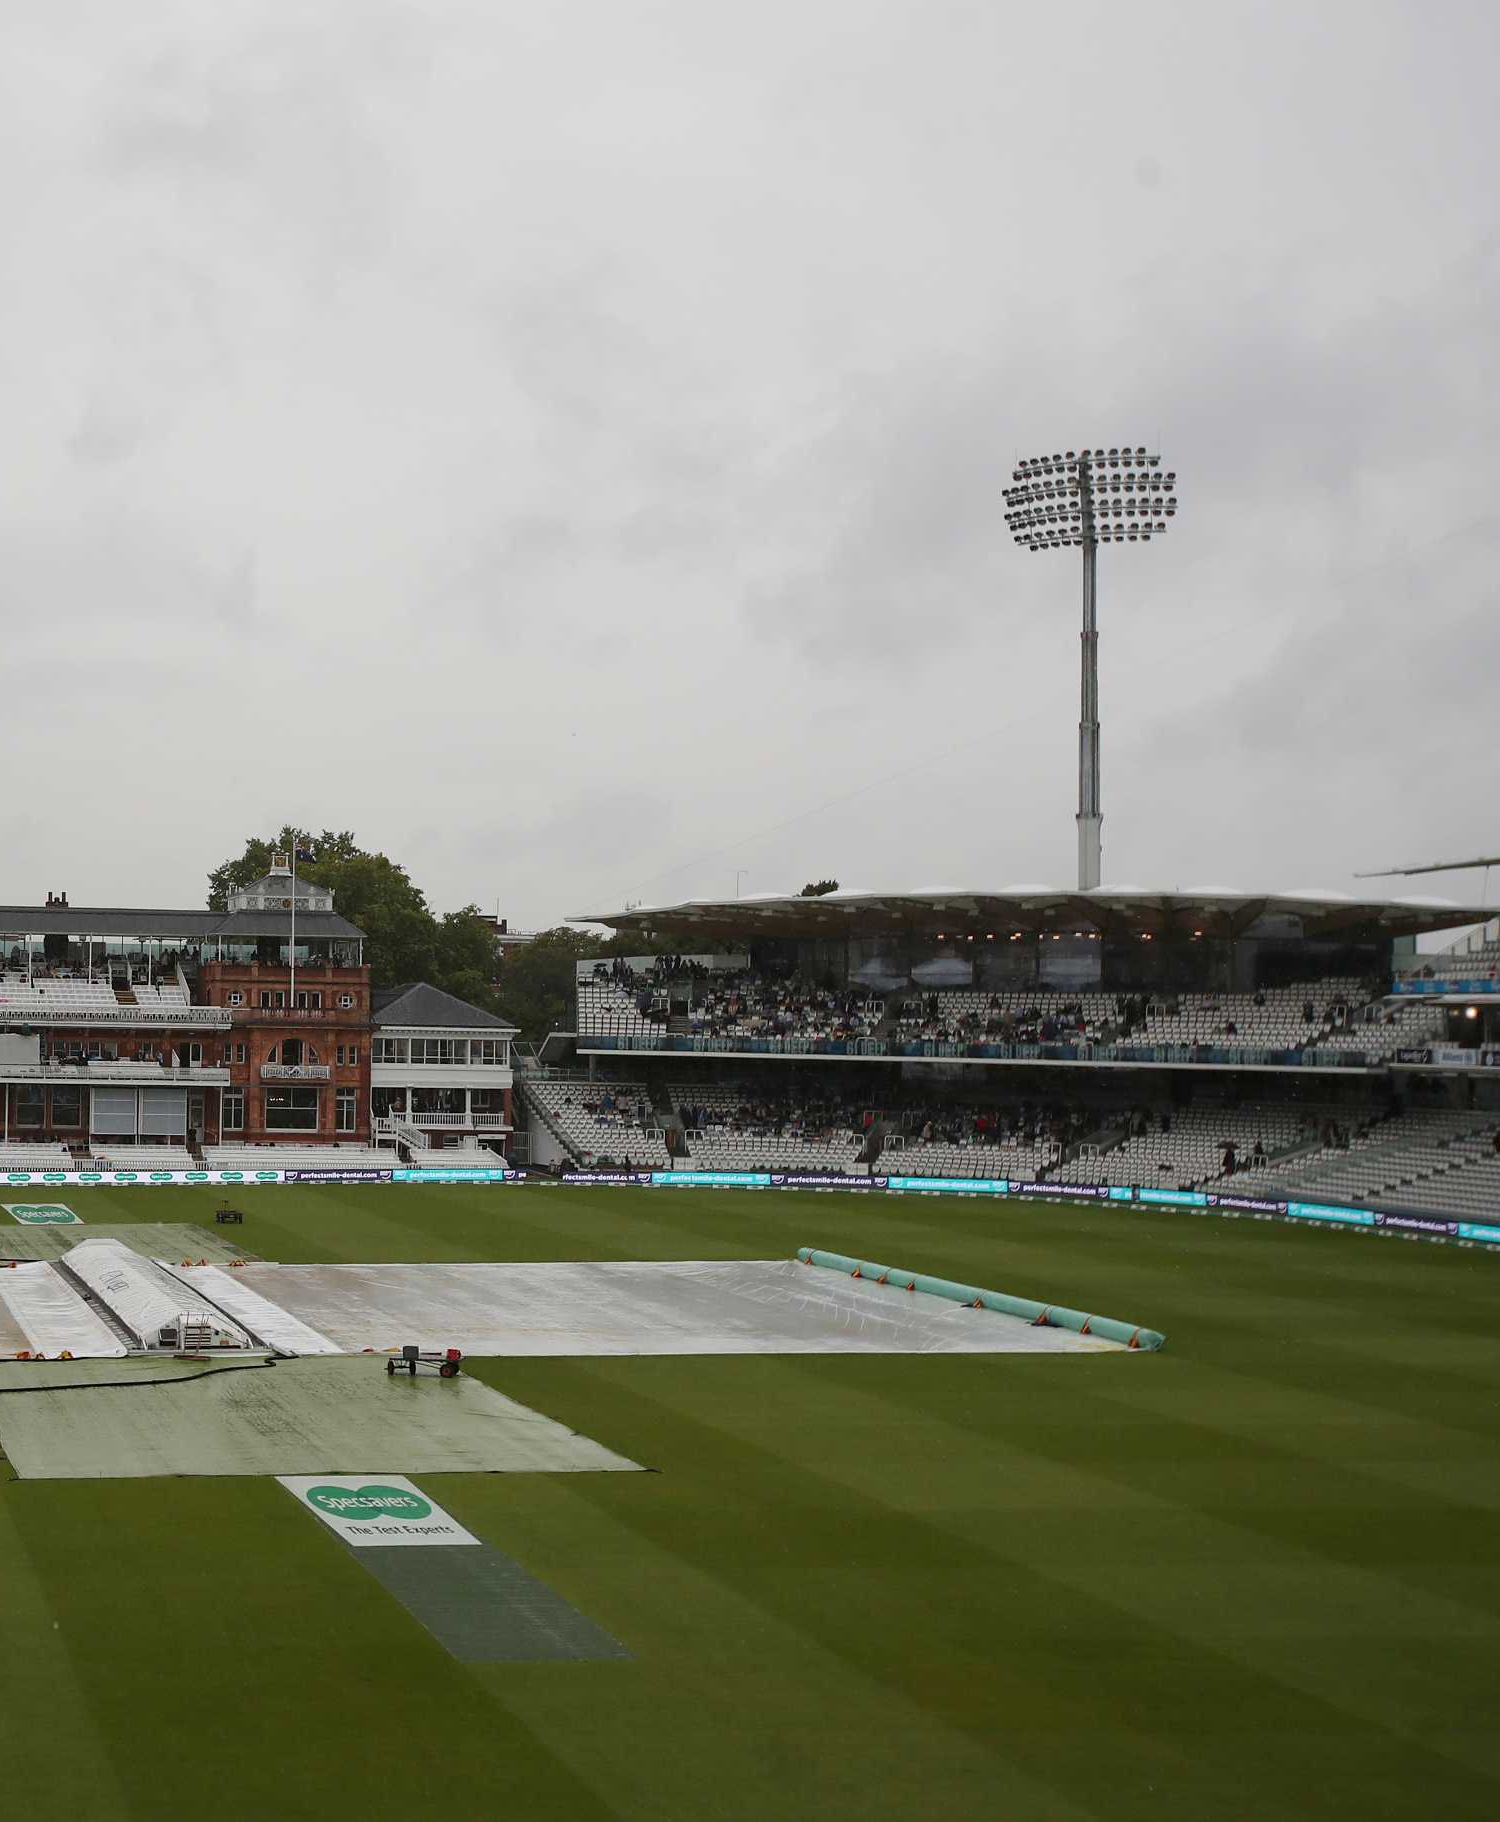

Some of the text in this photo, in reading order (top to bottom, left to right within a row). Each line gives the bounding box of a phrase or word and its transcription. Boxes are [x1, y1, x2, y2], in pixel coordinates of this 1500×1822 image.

[300, 1171, 378, 1180] perfectsmile-dental.com
[787, 1176, 872, 1186] perfectsmile-dental.com
[16, 1208, 68, 1218] Specsavers
[317, 1495, 418, 1511] Specsavers
[345, 1525, 455, 1537] The Test Experts
